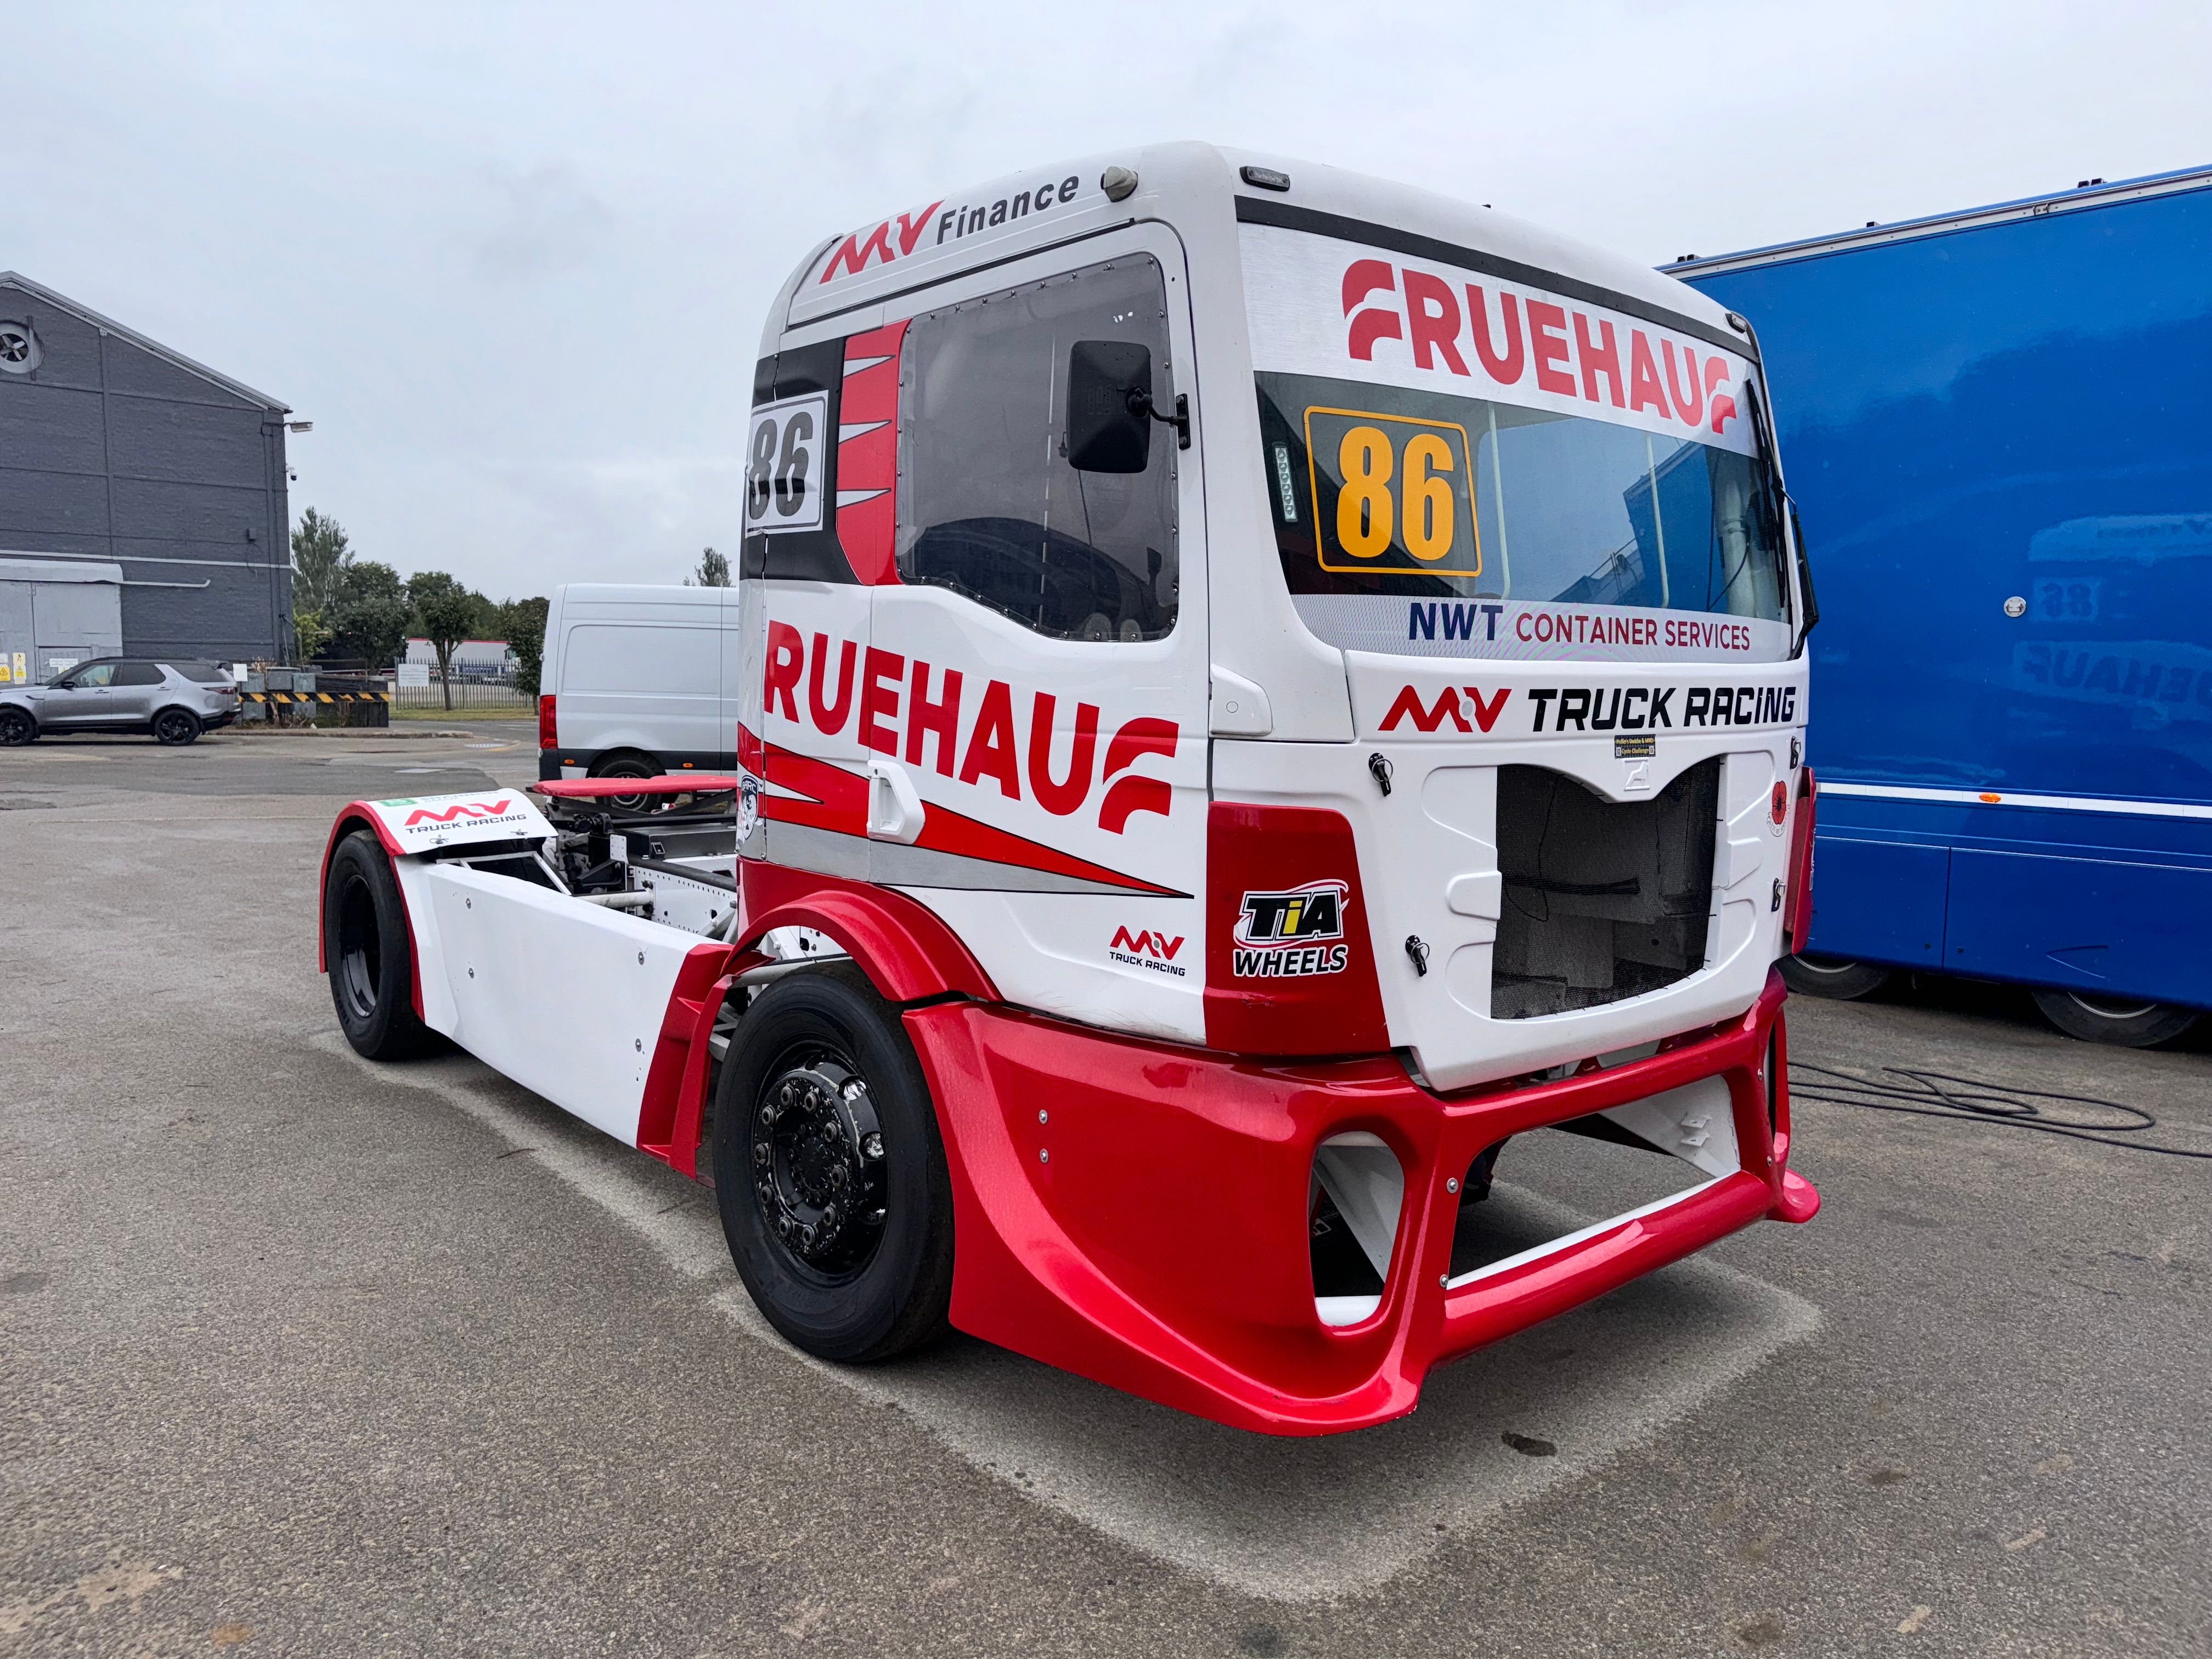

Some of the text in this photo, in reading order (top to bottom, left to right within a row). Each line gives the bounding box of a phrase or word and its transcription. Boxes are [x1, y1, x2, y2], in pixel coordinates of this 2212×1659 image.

[936, 176, 1079, 245] Finance
[749, 412, 813, 520] 86
[1336, 426, 1454, 560] 86
[1409, 603, 1750, 651] NWT CONTAINER SERVICES
[1527, 687, 1676, 732] TRUCK
[1683, 686, 1797, 727] RACING
[406, 814, 527, 834] TRUCK RACING
[1110, 951, 1186, 977] TRUCK RACING
[1234, 946, 1347, 975] WHEELS
